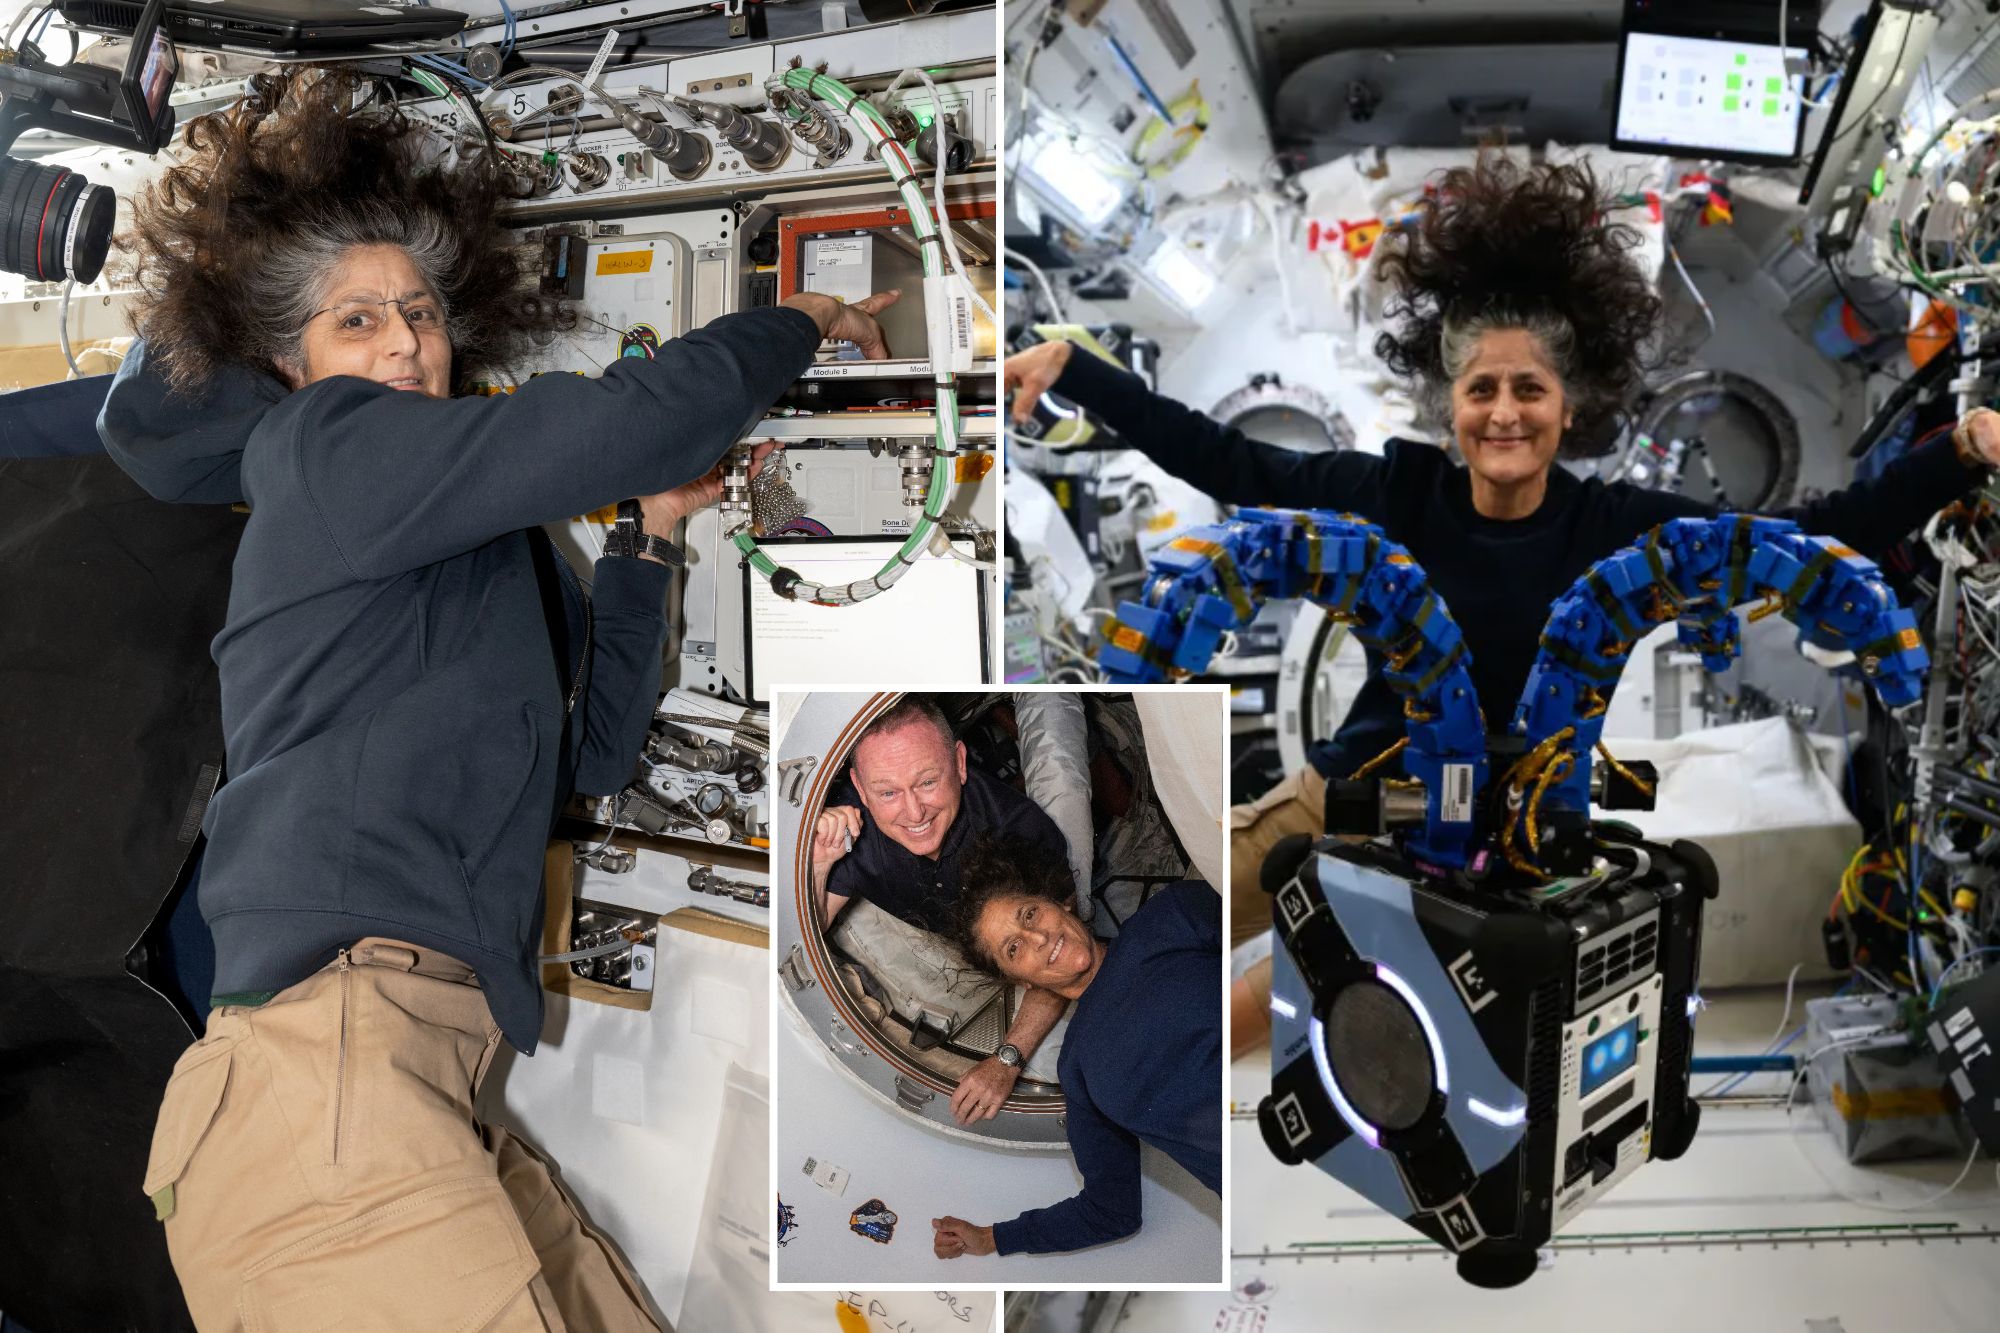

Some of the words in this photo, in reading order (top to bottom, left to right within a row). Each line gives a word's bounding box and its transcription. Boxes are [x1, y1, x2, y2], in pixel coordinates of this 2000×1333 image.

[513, 93, 526, 116] 5
[580, 145, 602, 153] LOCKER
[909, 365, 931, 373] Modu
